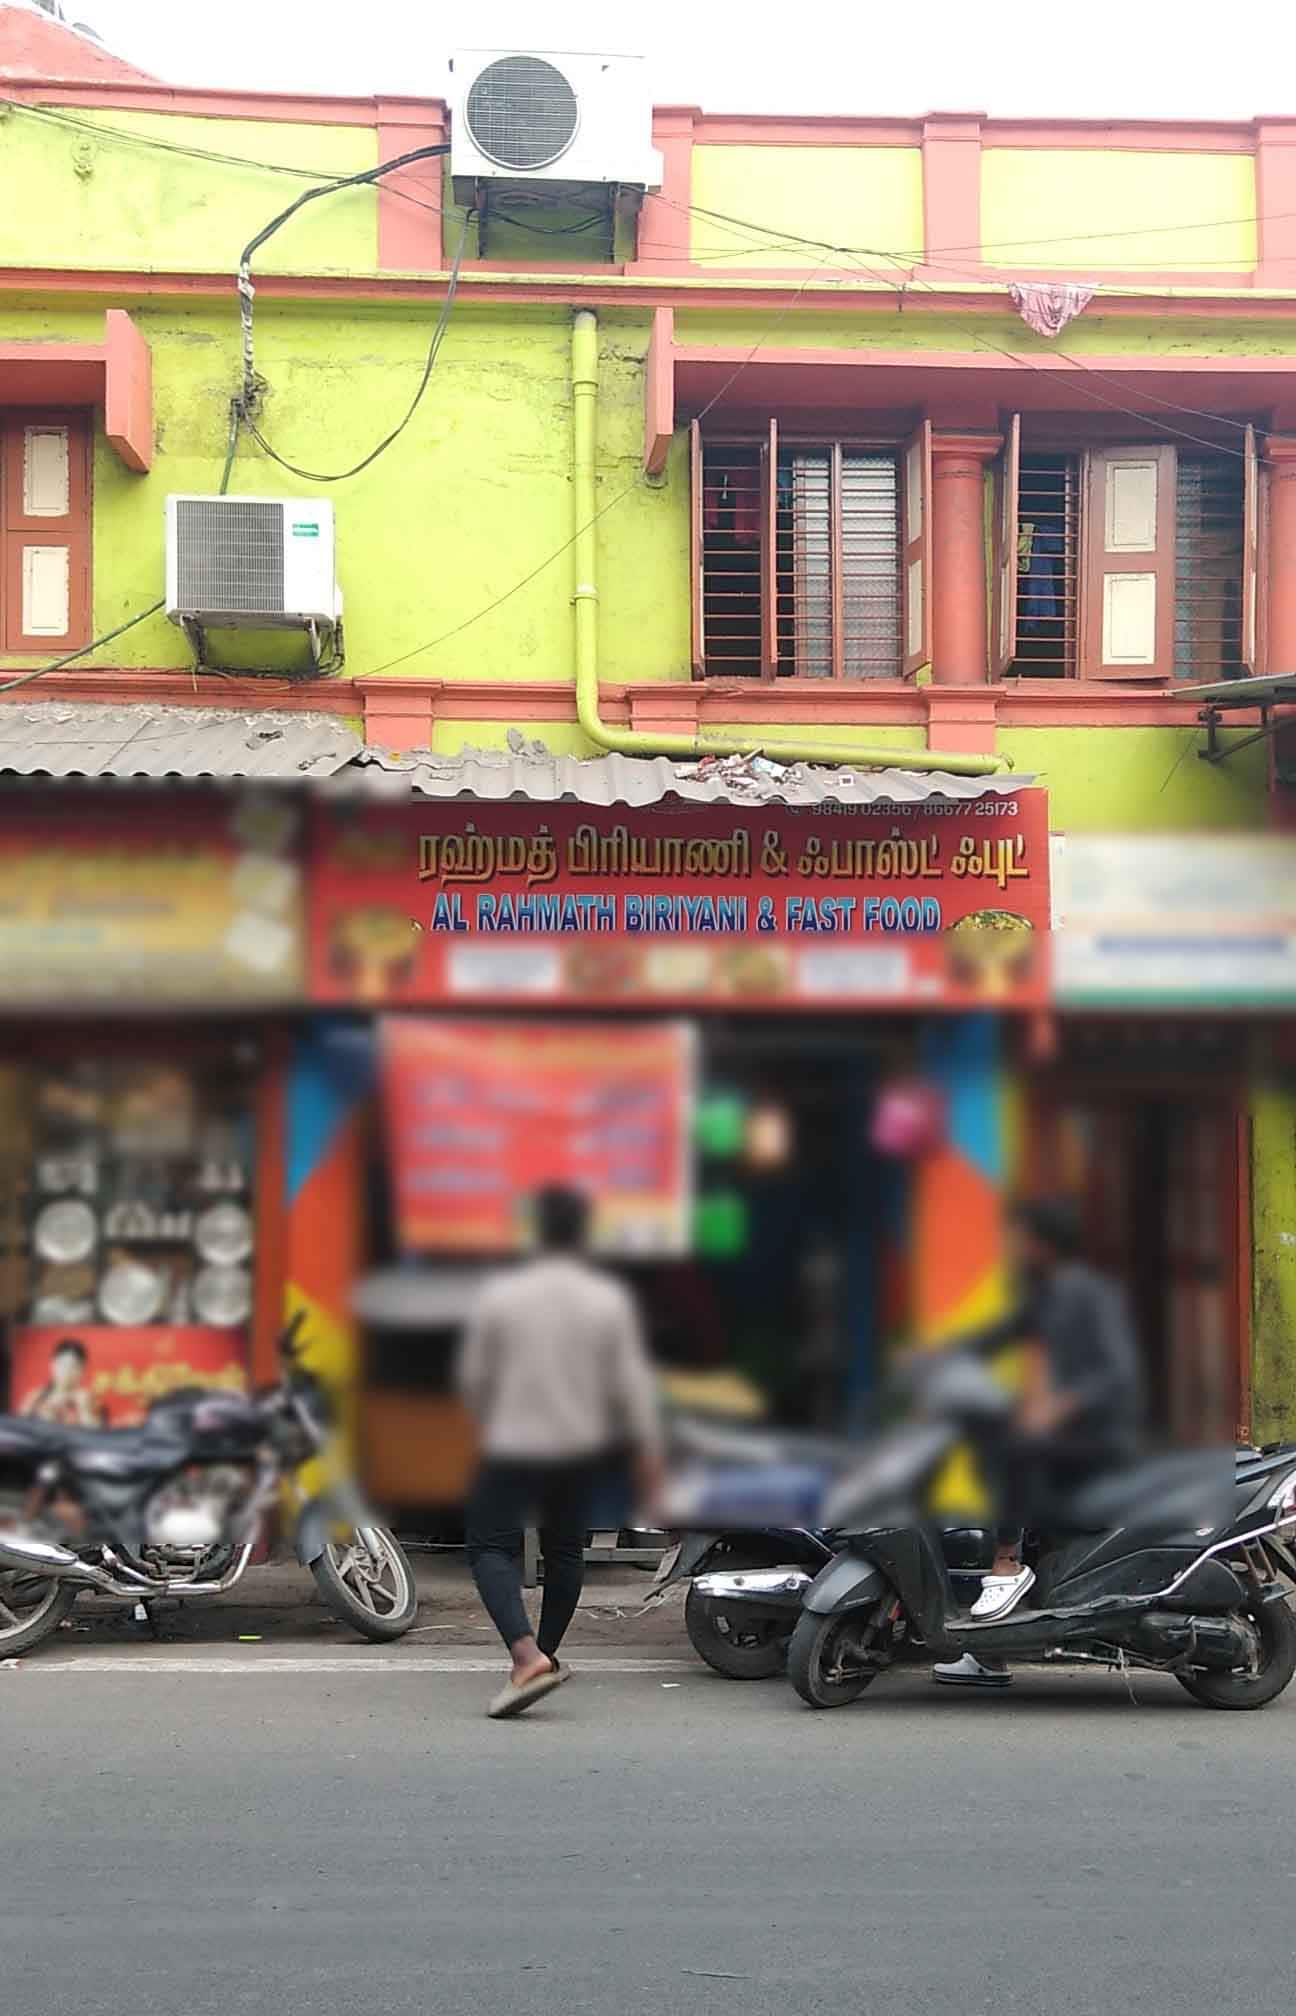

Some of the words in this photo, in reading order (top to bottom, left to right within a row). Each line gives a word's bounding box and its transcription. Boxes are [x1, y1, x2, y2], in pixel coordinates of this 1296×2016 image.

[923, 802, 971, 816] 86677
[975, 801, 1019, 816] 25173
[418, 822, 557, 884] ரஹ்மத்
[568, 824, 752, 873] பிரியாணி
[762, 830, 788, 874] &
[799, 827, 942, 876] ஃபாஸ்ட்
[951, 834, 1029, 888] ஃபுட்
[432, 894, 468, 932] AL
[479, 894, 615, 932] RAHMATH
[625, 895, 746, 932] BIRIYANI
[757, 895, 777, 932] &
[786, 896, 857, 932] FAST
[864, 896, 942, 932] FOOD
